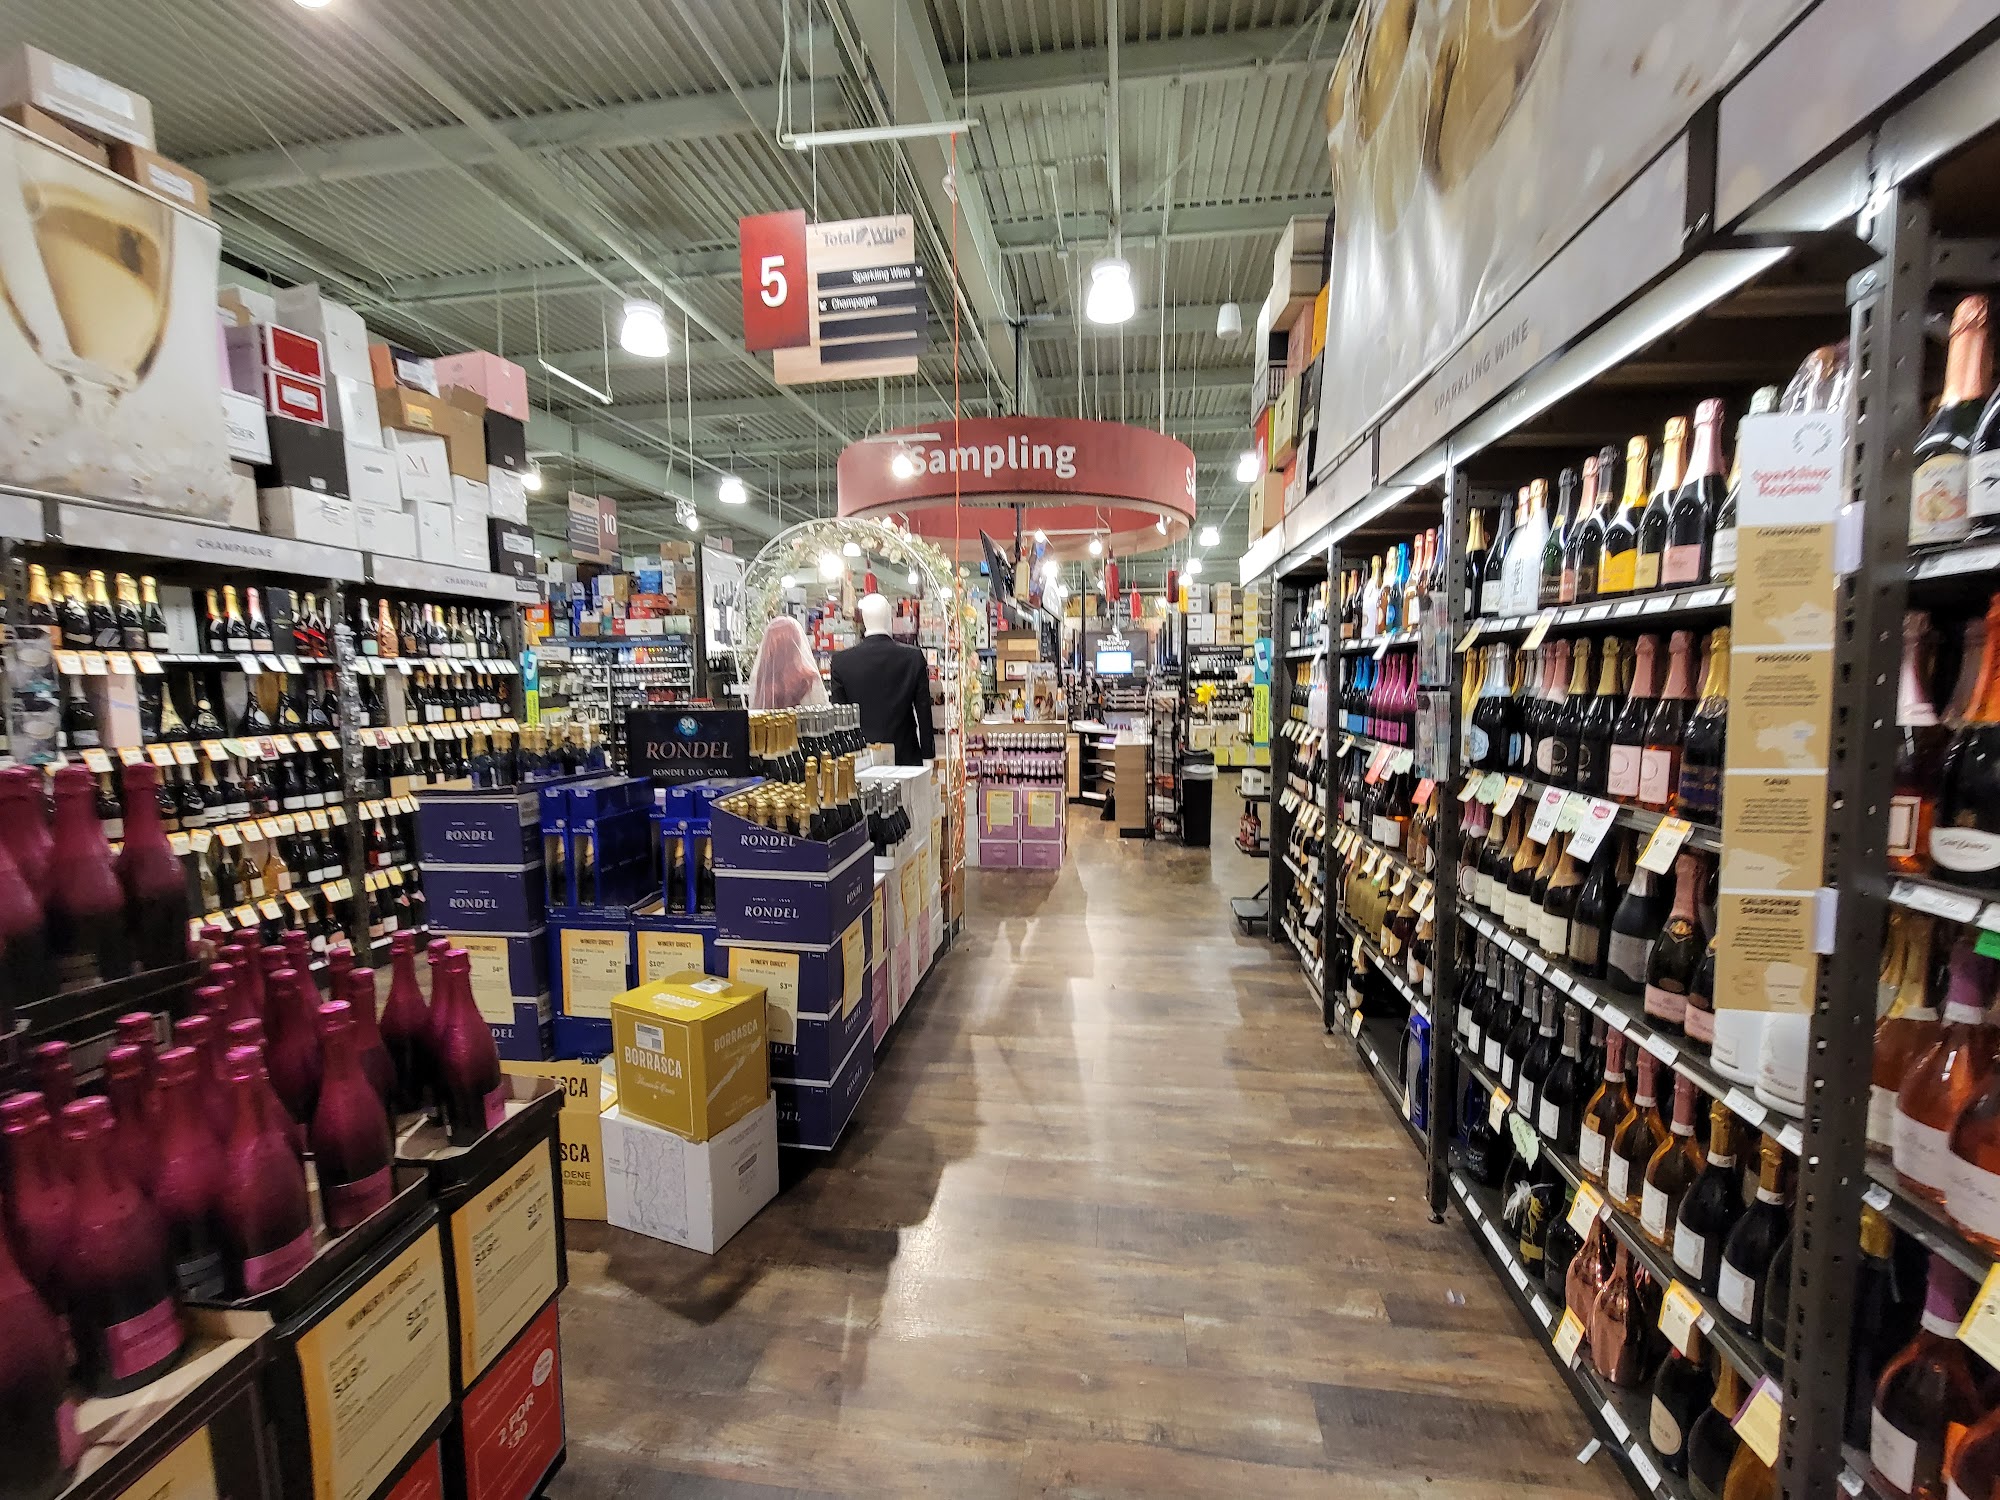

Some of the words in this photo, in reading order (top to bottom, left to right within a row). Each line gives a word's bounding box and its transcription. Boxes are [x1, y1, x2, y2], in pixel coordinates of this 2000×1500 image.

[823, 231, 854, 248] Total
[760, 254, 788, 308] 5
[852, 269, 889, 284] Sparkling
[890, 266, 911, 280] Wine
[831, 295, 878, 311] Champagne
[1434, 352, 1491, 416] SPARKLING
[1495, 317, 1529, 366] WINE
[911, 435, 1077, 479] Sampling
[602, 512, 617, 535] 10
[195, 537, 273, 559] CHAMPAGNE
[444, 575, 489, 590] CHAMPAGNE
[680, 717, 696, 729] 90
[646, 741, 733, 760] RONDEL
[653, 768, 685, 777] RONDEL
[707, 768, 728, 777] CAVA
[446, 829, 495, 841] RONDEL
[740, 834, 797, 848] RONDEL
[449, 897, 499, 909] RONDEL
[744, 905, 800, 919] RONDEL
[492, 1027, 515, 1039] DEL
[714, 1018, 759, 1053] BORRASCA
[773, 1043, 799, 1056] DEL
[624, 1045, 683, 1080] BORRASCA
[563, 1169, 591, 1180] DENE
[498, 1427, 508, 1447] 2
[508, 1391, 535, 1433] FOR
